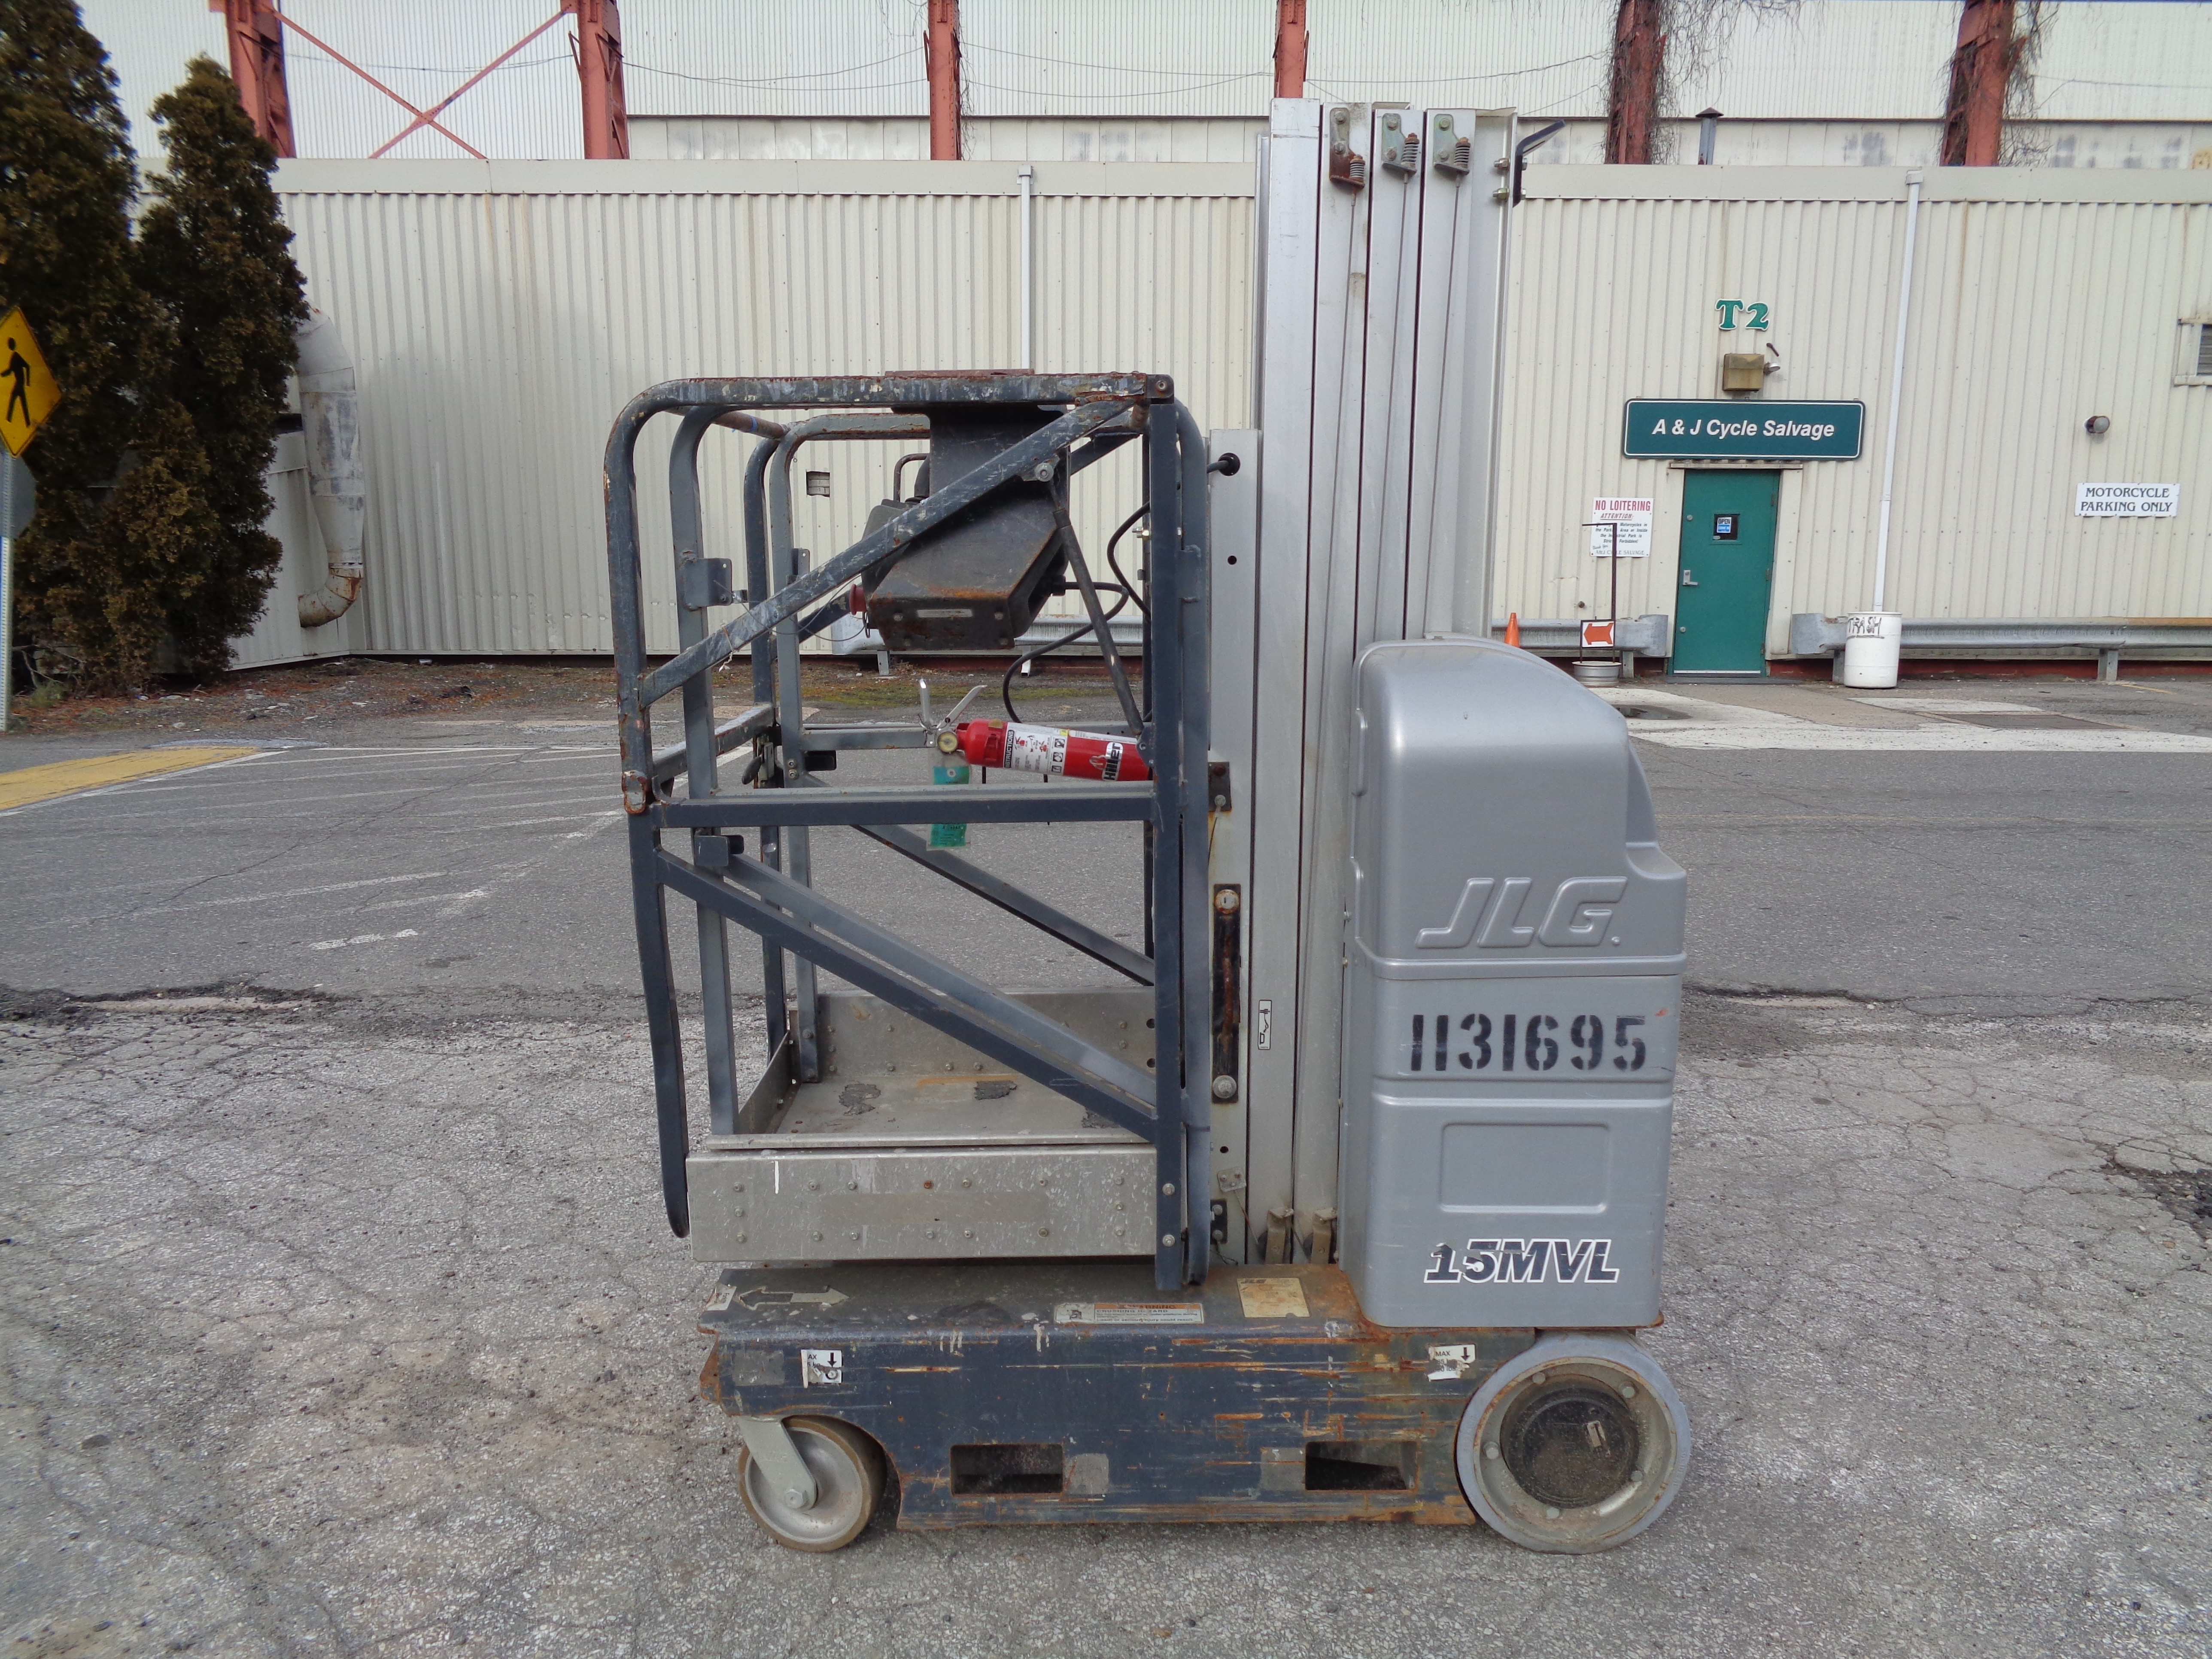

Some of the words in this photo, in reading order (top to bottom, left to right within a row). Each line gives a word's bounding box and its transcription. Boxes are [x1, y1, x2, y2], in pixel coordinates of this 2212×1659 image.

[1715, 298, 1770, 331] T2
[1652, 419, 1666, 434] A
[1672, 419, 1685, 435] &
[1690, 419, 1702, 435] J
[1707, 419, 1757, 439] Cycle
[1763, 420, 1834, 441] Salvage
[2085, 487, 2169, 498] MOTORCYCLE
[1595, 500, 1606, 510] NO
[1610, 500, 1651, 511] LOITERING
[2080, 501, 2136, 511] PARKING
[2141, 502, 2173, 512] ONLY
[1847, 616, 1882, 636] TRASH
[1416, 876, 1628, 949] JLG
[1410, 1013, 1647, 1072] 1131695
[1423, 1238, 1620, 1283] 15MVL
